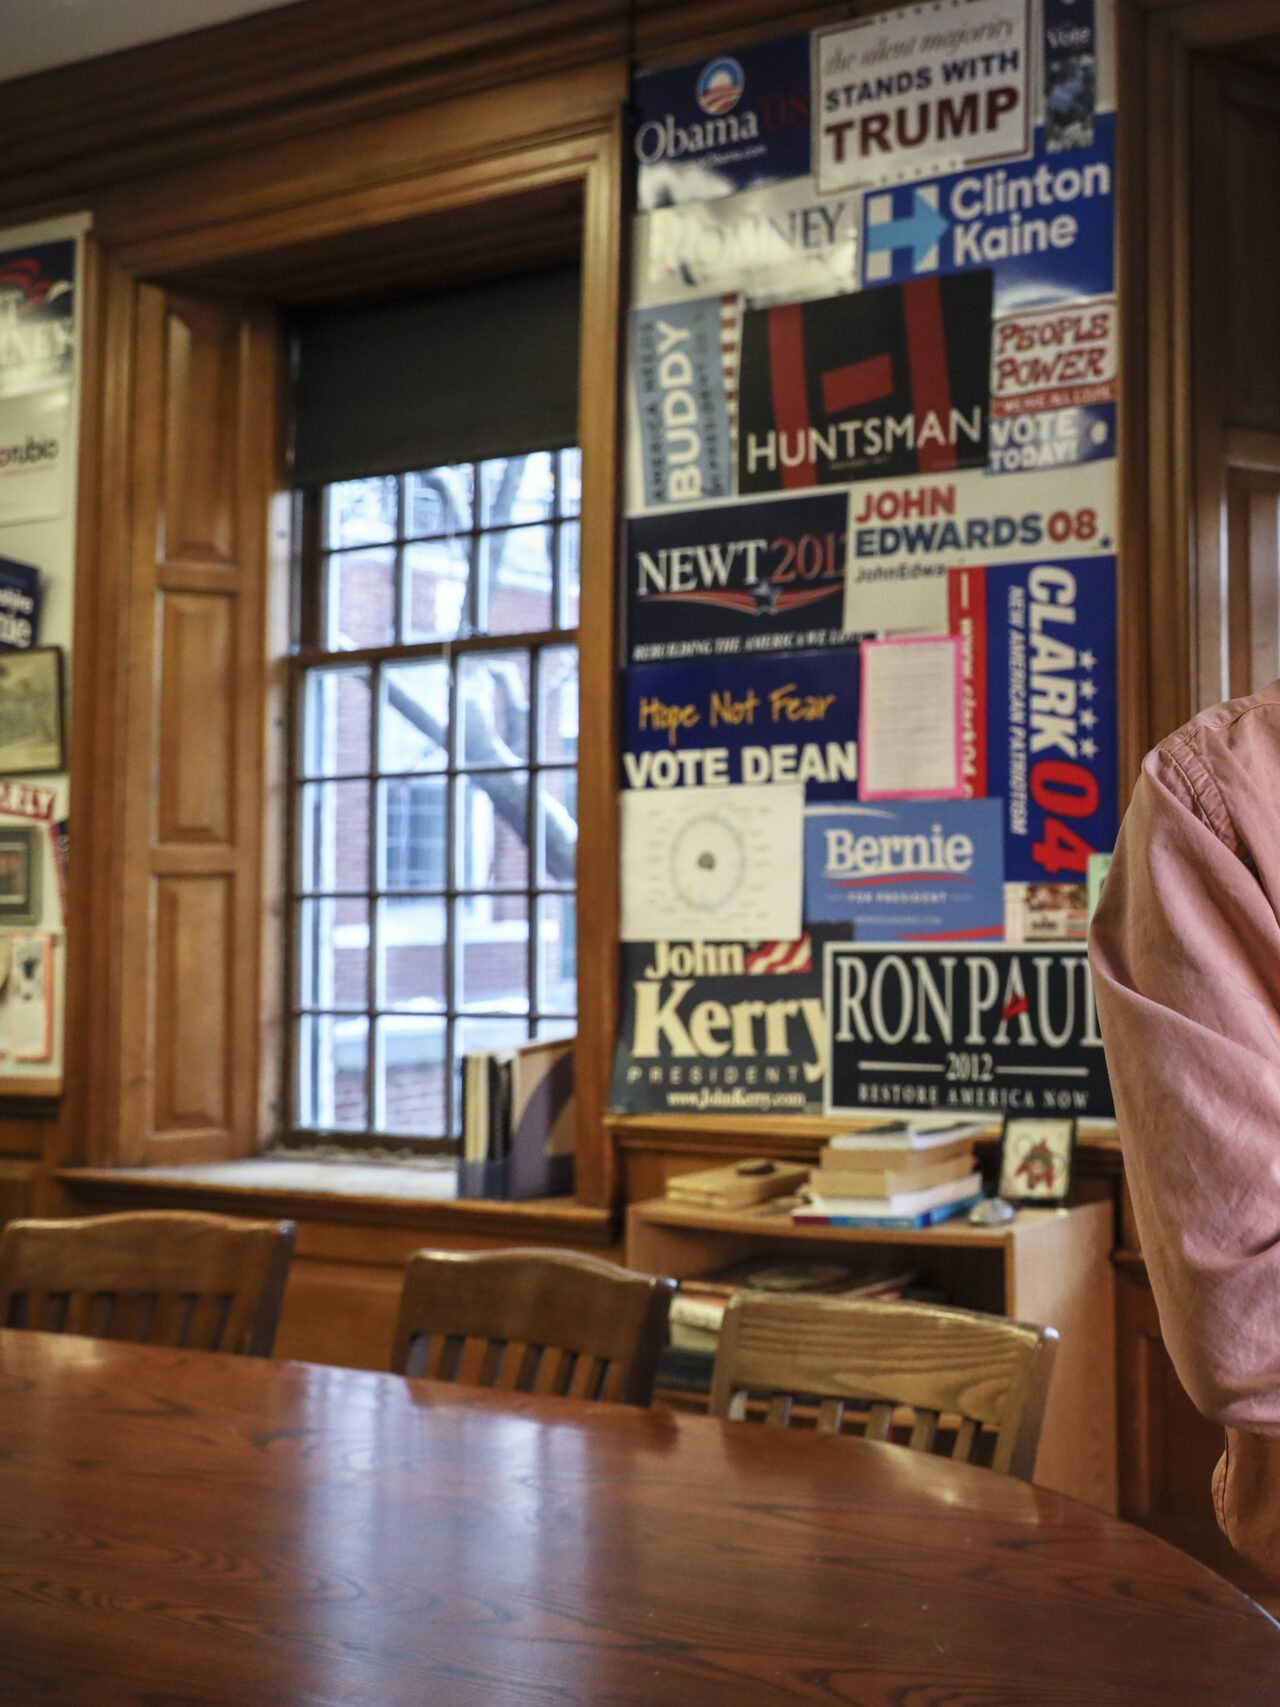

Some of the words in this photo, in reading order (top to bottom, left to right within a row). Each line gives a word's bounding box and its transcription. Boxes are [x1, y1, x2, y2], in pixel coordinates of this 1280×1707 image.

[825, 66, 932, 113] STANDS
[942, 50, 1019, 84] WITH
[635, 111, 759, 165] Obama
[825, 86, 1019, 164] TRUMP
[950, 163, 1111, 220] Clinton
[953, 211, 1079, 267] Kaine
[997, 312, 1110, 356] PEOPLE
[996, 348, 1106, 391] POWER
[655, 320, 702, 500] BUDDY
[989, 408, 1078, 448] VOTE
[746, 405, 982, 474] HUNTSMAN
[855, 485, 956, 524] JOHN
[855, 513, 1043, 558] EDWARDS
[1047, 508, 1098, 543] 08
[637, 538, 768, 596] NEWT
[770, 532, 847, 584] 201
[1009, 585, 1027, 628] NEW
[632, 639, 714, 662] REBUILDING
[714, 635, 743, 654] THE
[744, 631, 802, 651] AMERICA
[1027, 565, 1078, 759] CLARK
[1009, 629, 1027, 724] AMERICAN
[639, 697, 700, 746] Hope
[710, 688, 760, 728] Not
[769, 683, 836, 723] Fear
[623, 748, 730, 789] VOTE
[741, 741, 858, 784] DEAN
[1009, 725, 1028, 835] PATRIOTISM
[1029, 759, 1099, 875] 04
[824, 825, 974, 874] Bernie
[847, 890, 873, 904] FOR
[874, 890, 948, 904] PRESIDENT
[644, 940, 746, 980] John
[835, 954, 958, 1045] RON
[964, 955, 1105, 1048] PAUL
[631, 980, 828, 1084] Kerry
[626, 1065, 800, 1086] PRESIDENT
[944, 1052, 995, 1083] 2012
[857, 1084, 940, 1107] RESTORE
[948, 1086, 1036, 1109] AMERICA
[1043, 1090, 1090, 1111] NOW
